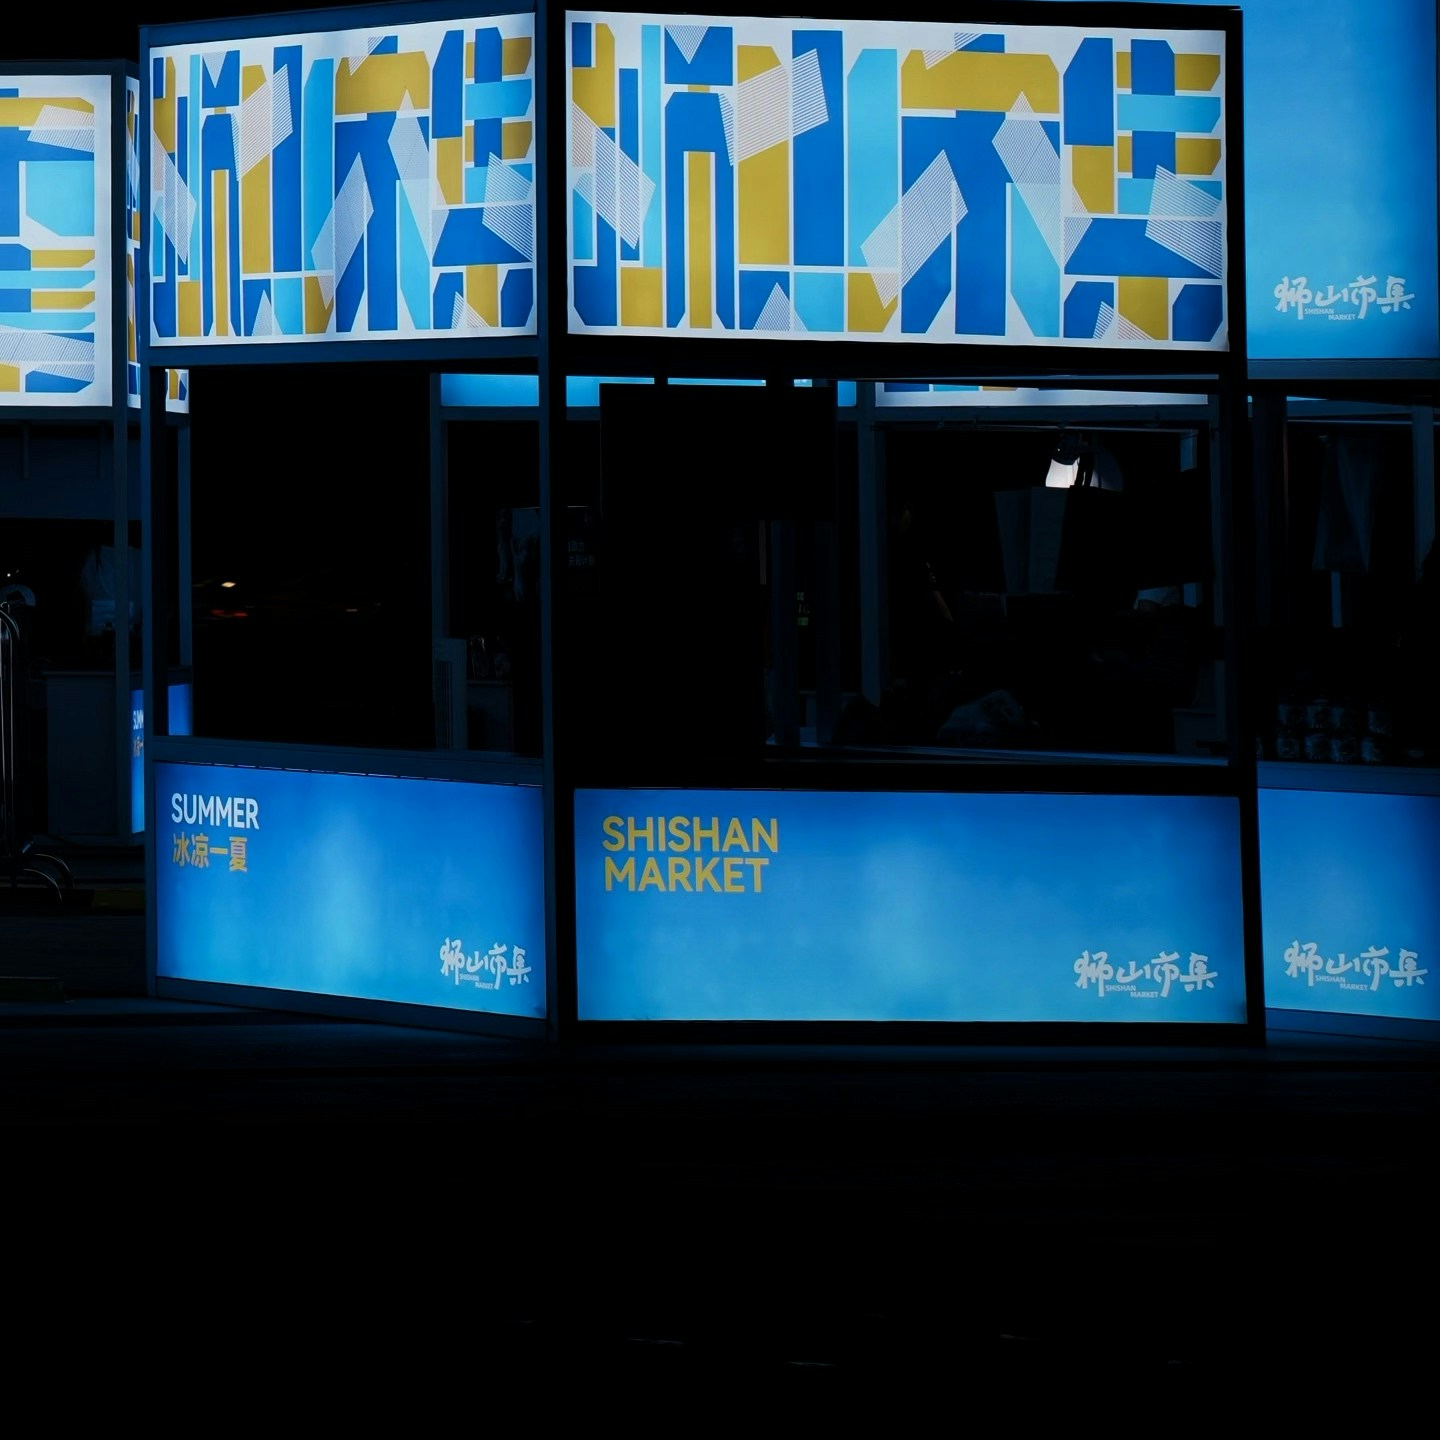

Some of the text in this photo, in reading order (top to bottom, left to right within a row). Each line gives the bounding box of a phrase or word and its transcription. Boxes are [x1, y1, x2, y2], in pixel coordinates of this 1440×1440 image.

[1273, 274, 1416, 321] 狮山市集
[171, 792, 260, 830] SUMMER
[172, 831, 248, 873] 冰凉一夏
[602, 815, 779, 853] SHISHAN
[604, 856, 770, 893] MARKET
[439, 937, 532, 991] 狮山市集
[1073, 949, 1219, 998] 狮山市集
[1283, 939, 1429, 992] 狮山市集
